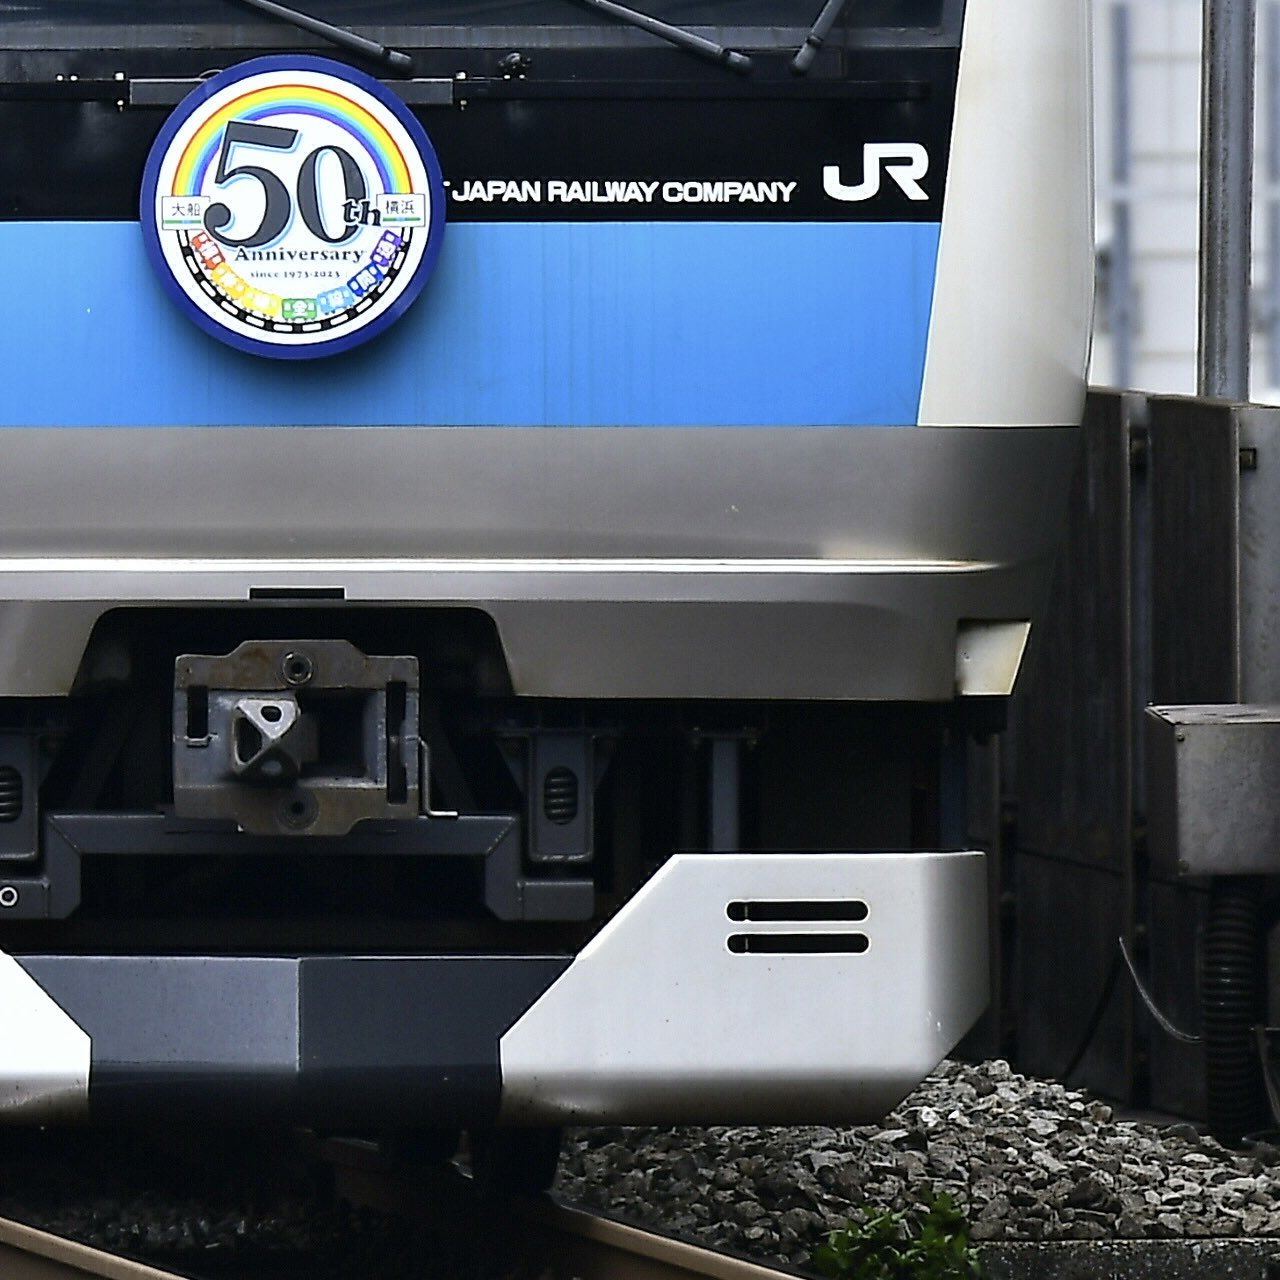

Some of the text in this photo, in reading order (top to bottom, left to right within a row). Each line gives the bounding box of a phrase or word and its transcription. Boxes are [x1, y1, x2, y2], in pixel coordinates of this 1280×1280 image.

[823, 142, 930, 202] JR
[451, 180, 797, 203] JAPAN RAILWAY COMPANY
[234, 247, 366, 264] Anniversary
[250, 270, 279, 278] since
